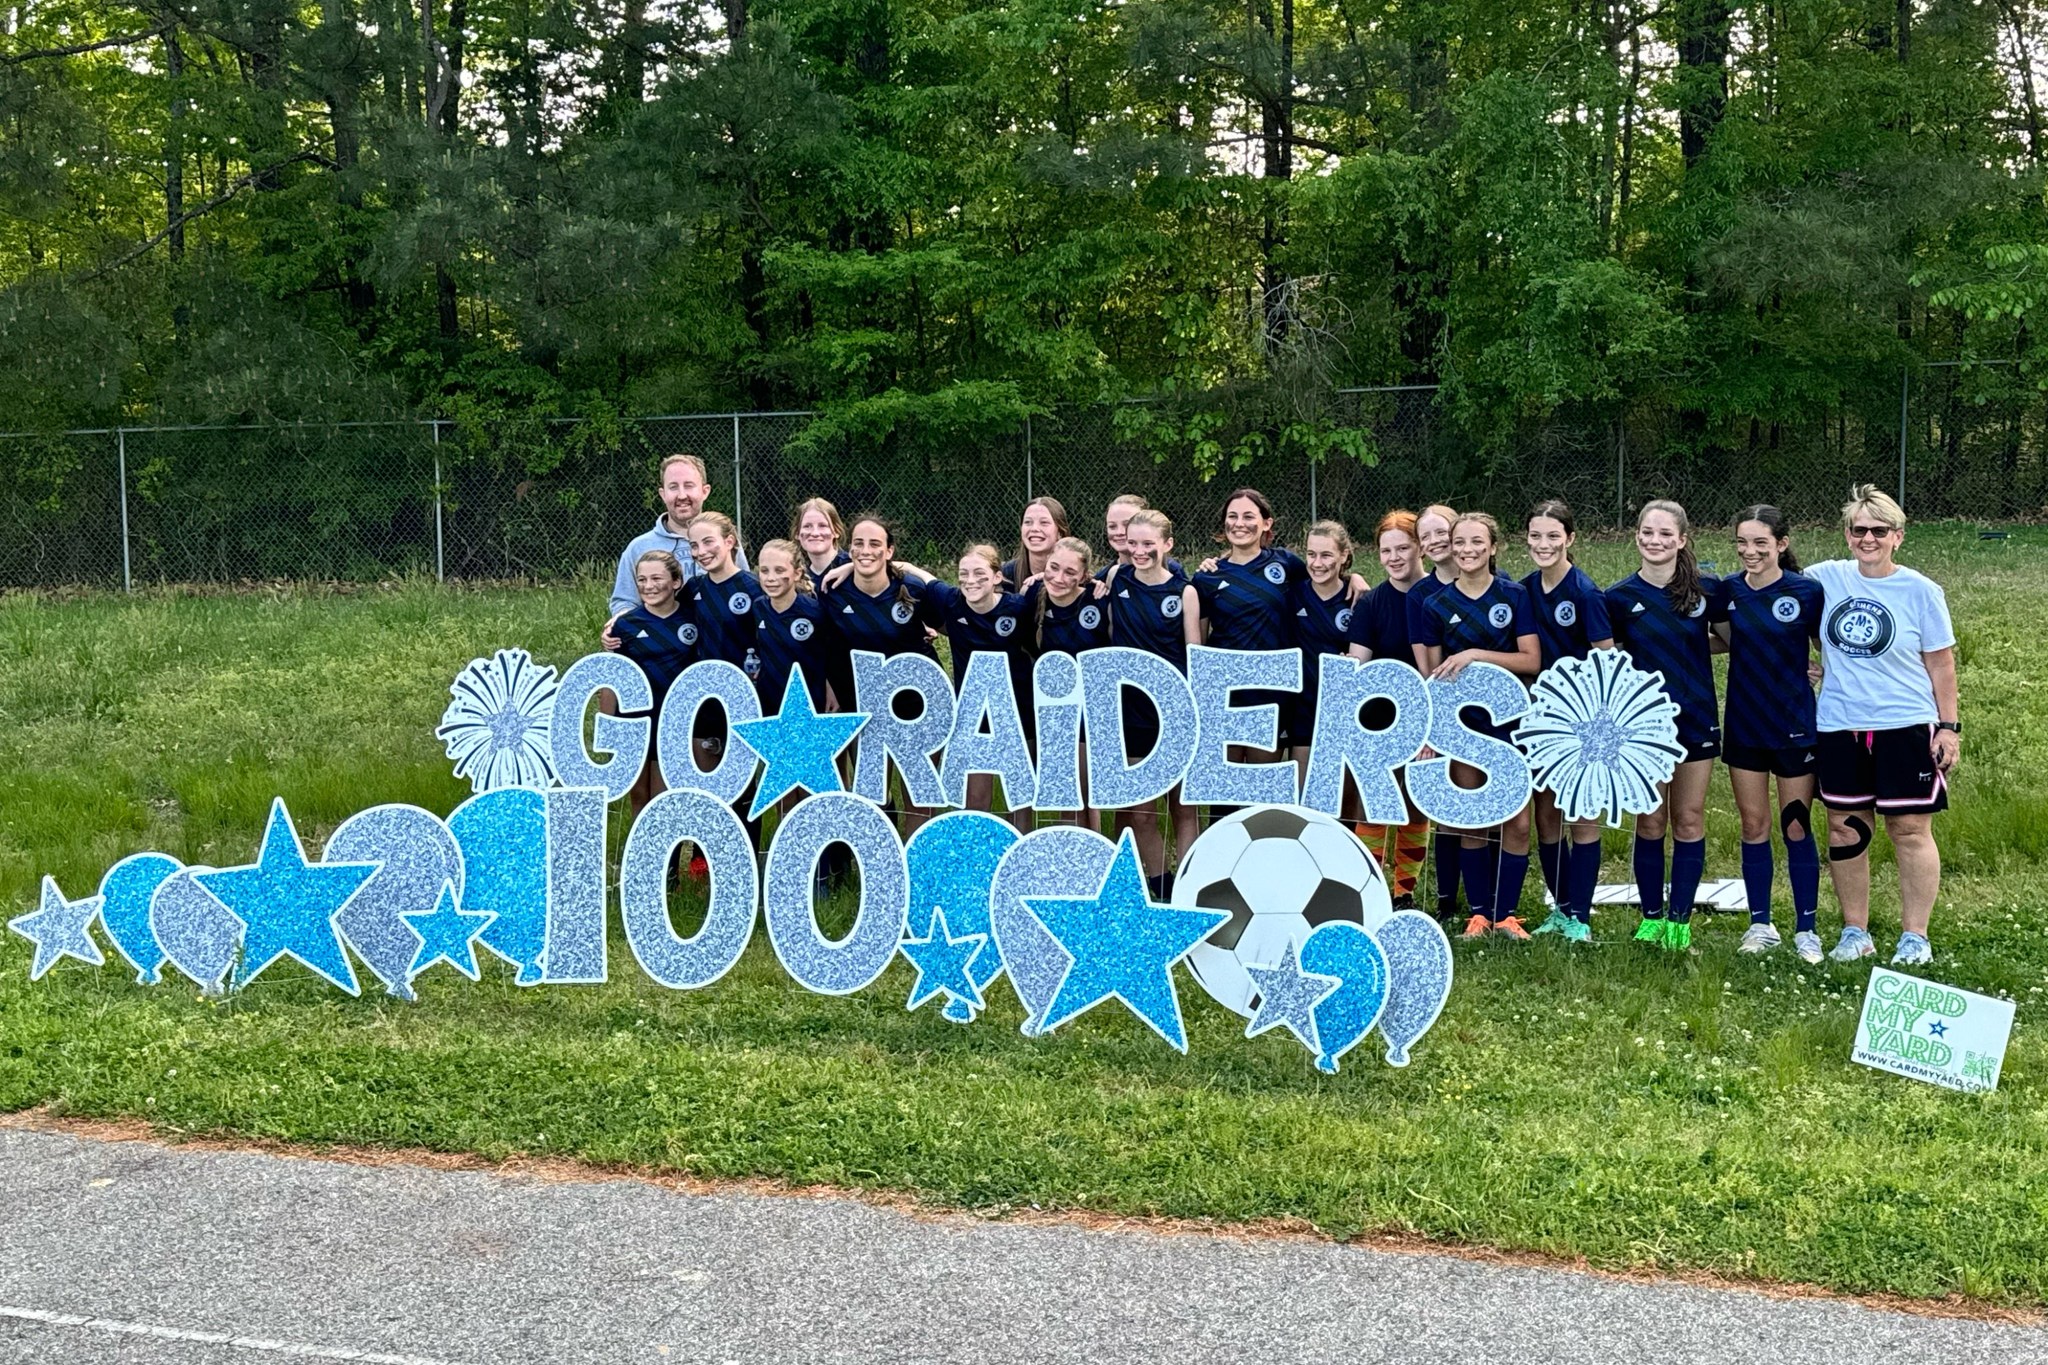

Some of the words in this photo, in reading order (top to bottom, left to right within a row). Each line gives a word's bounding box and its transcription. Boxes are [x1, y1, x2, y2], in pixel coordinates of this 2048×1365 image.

[1843, 614, 1873, 638] GMS
[1849, 601, 1883, 615] GTHENS
[1839, 642, 1872, 655] SOCCER
[549, 652, 764, 803] GO
[543, 786, 909, 995] 100
[1866, 997, 1925, 1032] MY
[1874, 975, 1968, 1018] CARD
[1866, 1022, 1952, 1067] YARD
